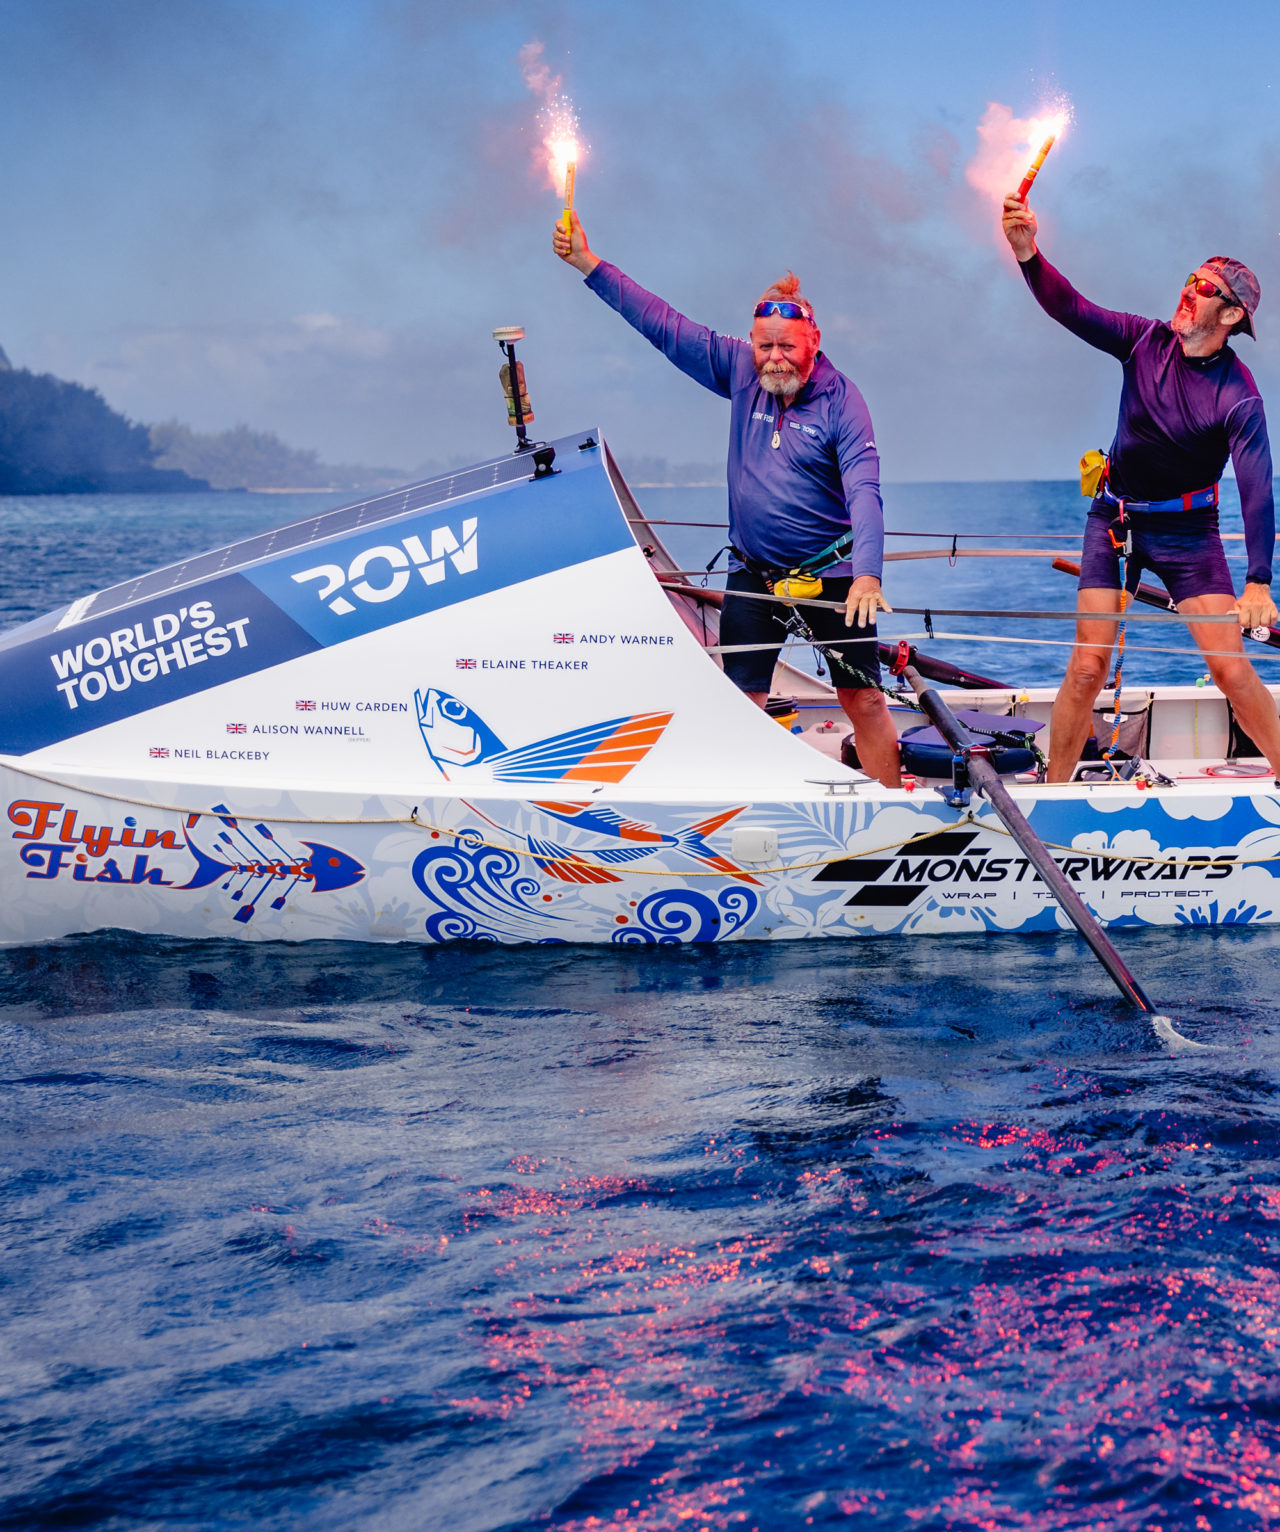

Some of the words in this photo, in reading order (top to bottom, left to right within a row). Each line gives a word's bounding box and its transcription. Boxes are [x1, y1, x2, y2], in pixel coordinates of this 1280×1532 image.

[290, 516, 479, 616] ROW
[50, 600, 217, 680] WORLD'S
[579, 634, 616, 645] ANDY
[620, 635, 674, 645] WARNER
[56, 617, 250, 710] TOUGHEST
[481, 659, 526, 670] ELAINE
[531, 660, 588, 670] THEAKER
[321, 702, 350, 711] HUW
[355, 702, 408, 712] CARDEN
[252, 725, 299, 735] ALISON
[304, 726, 364, 736] WANNELL
[174, 749, 201, 759] NEIL
[206, 750, 270, 761] BLACKEBY
[7, 799, 202, 857] Flyin'
[20, 842, 175, 885] Fish
[1121, 890, 1213, 898] PROTECT
